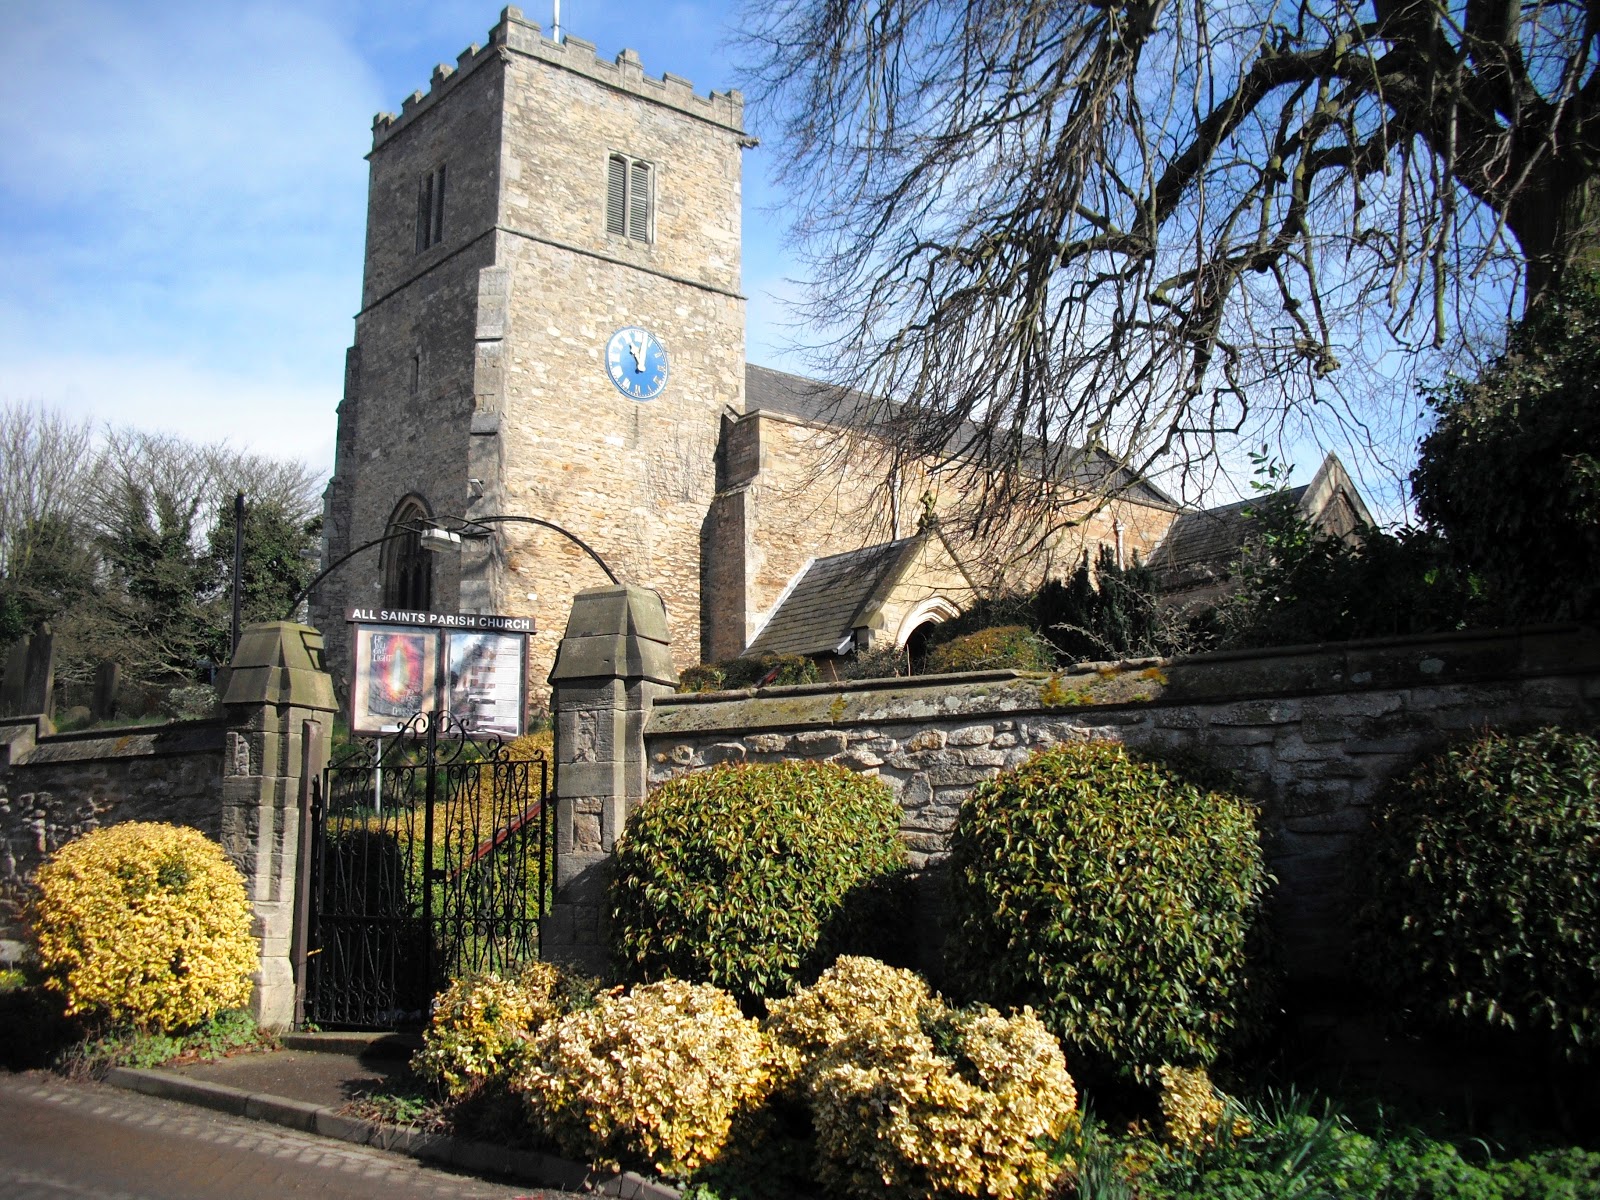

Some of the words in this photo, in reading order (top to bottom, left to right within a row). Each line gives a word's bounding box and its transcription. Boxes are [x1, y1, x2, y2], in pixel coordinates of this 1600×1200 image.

[352, 608, 377, 620] ALL
[380, 610, 426, 623] SAINTS
[429, 614, 475, 626] PARISH
[479, 617, 530, 630] CHURCH
[373, 654, 392, 662] LIGHT
